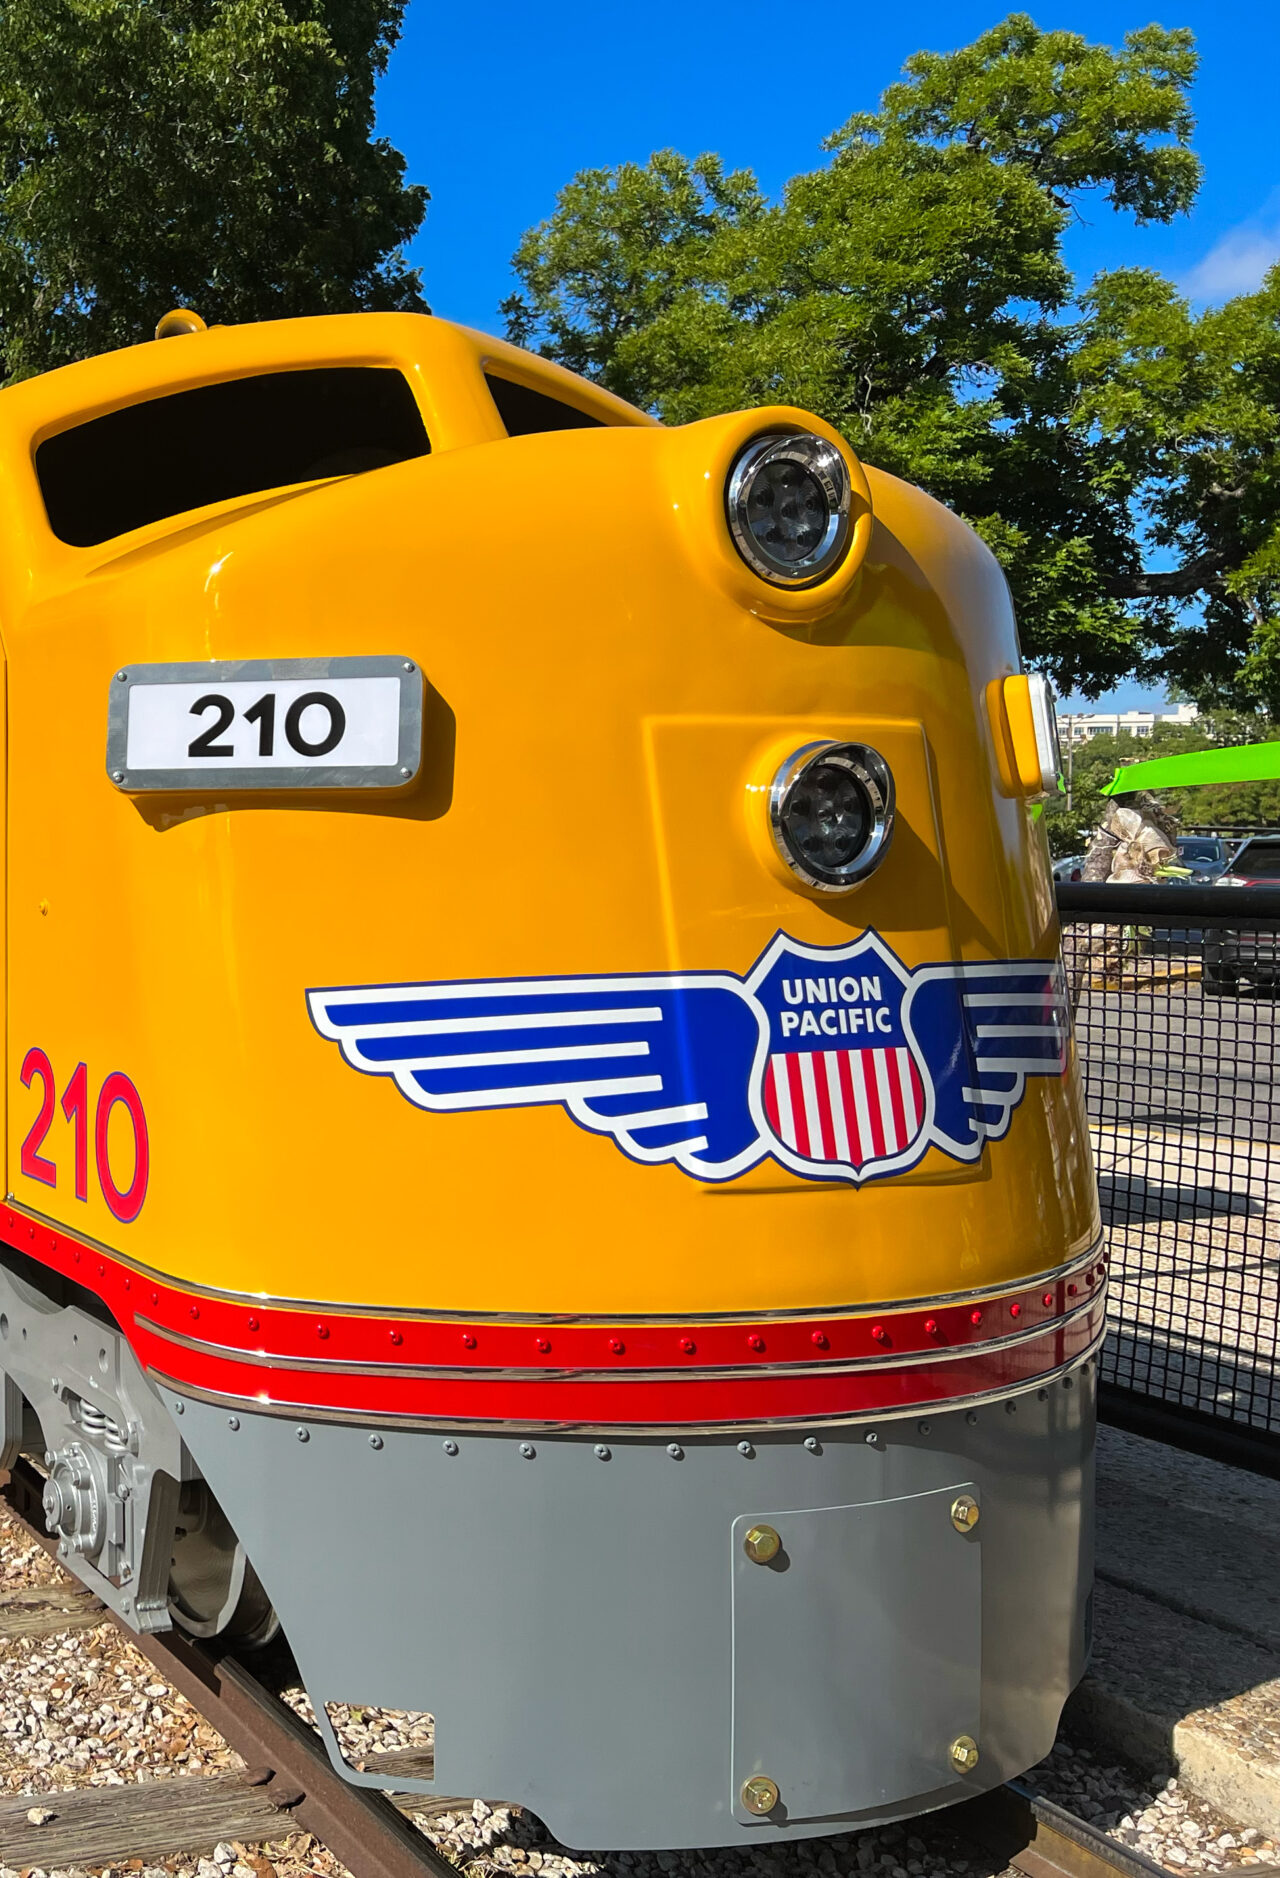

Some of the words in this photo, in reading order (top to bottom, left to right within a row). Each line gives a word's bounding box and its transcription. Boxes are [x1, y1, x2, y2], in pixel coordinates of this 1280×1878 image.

[188, 691, 346, 757] 210
[782, 976, 882, 1005] UNION
[780, 1007, 892, 1037] PACIFIC
[21, 1046, 149, 1224] 210
